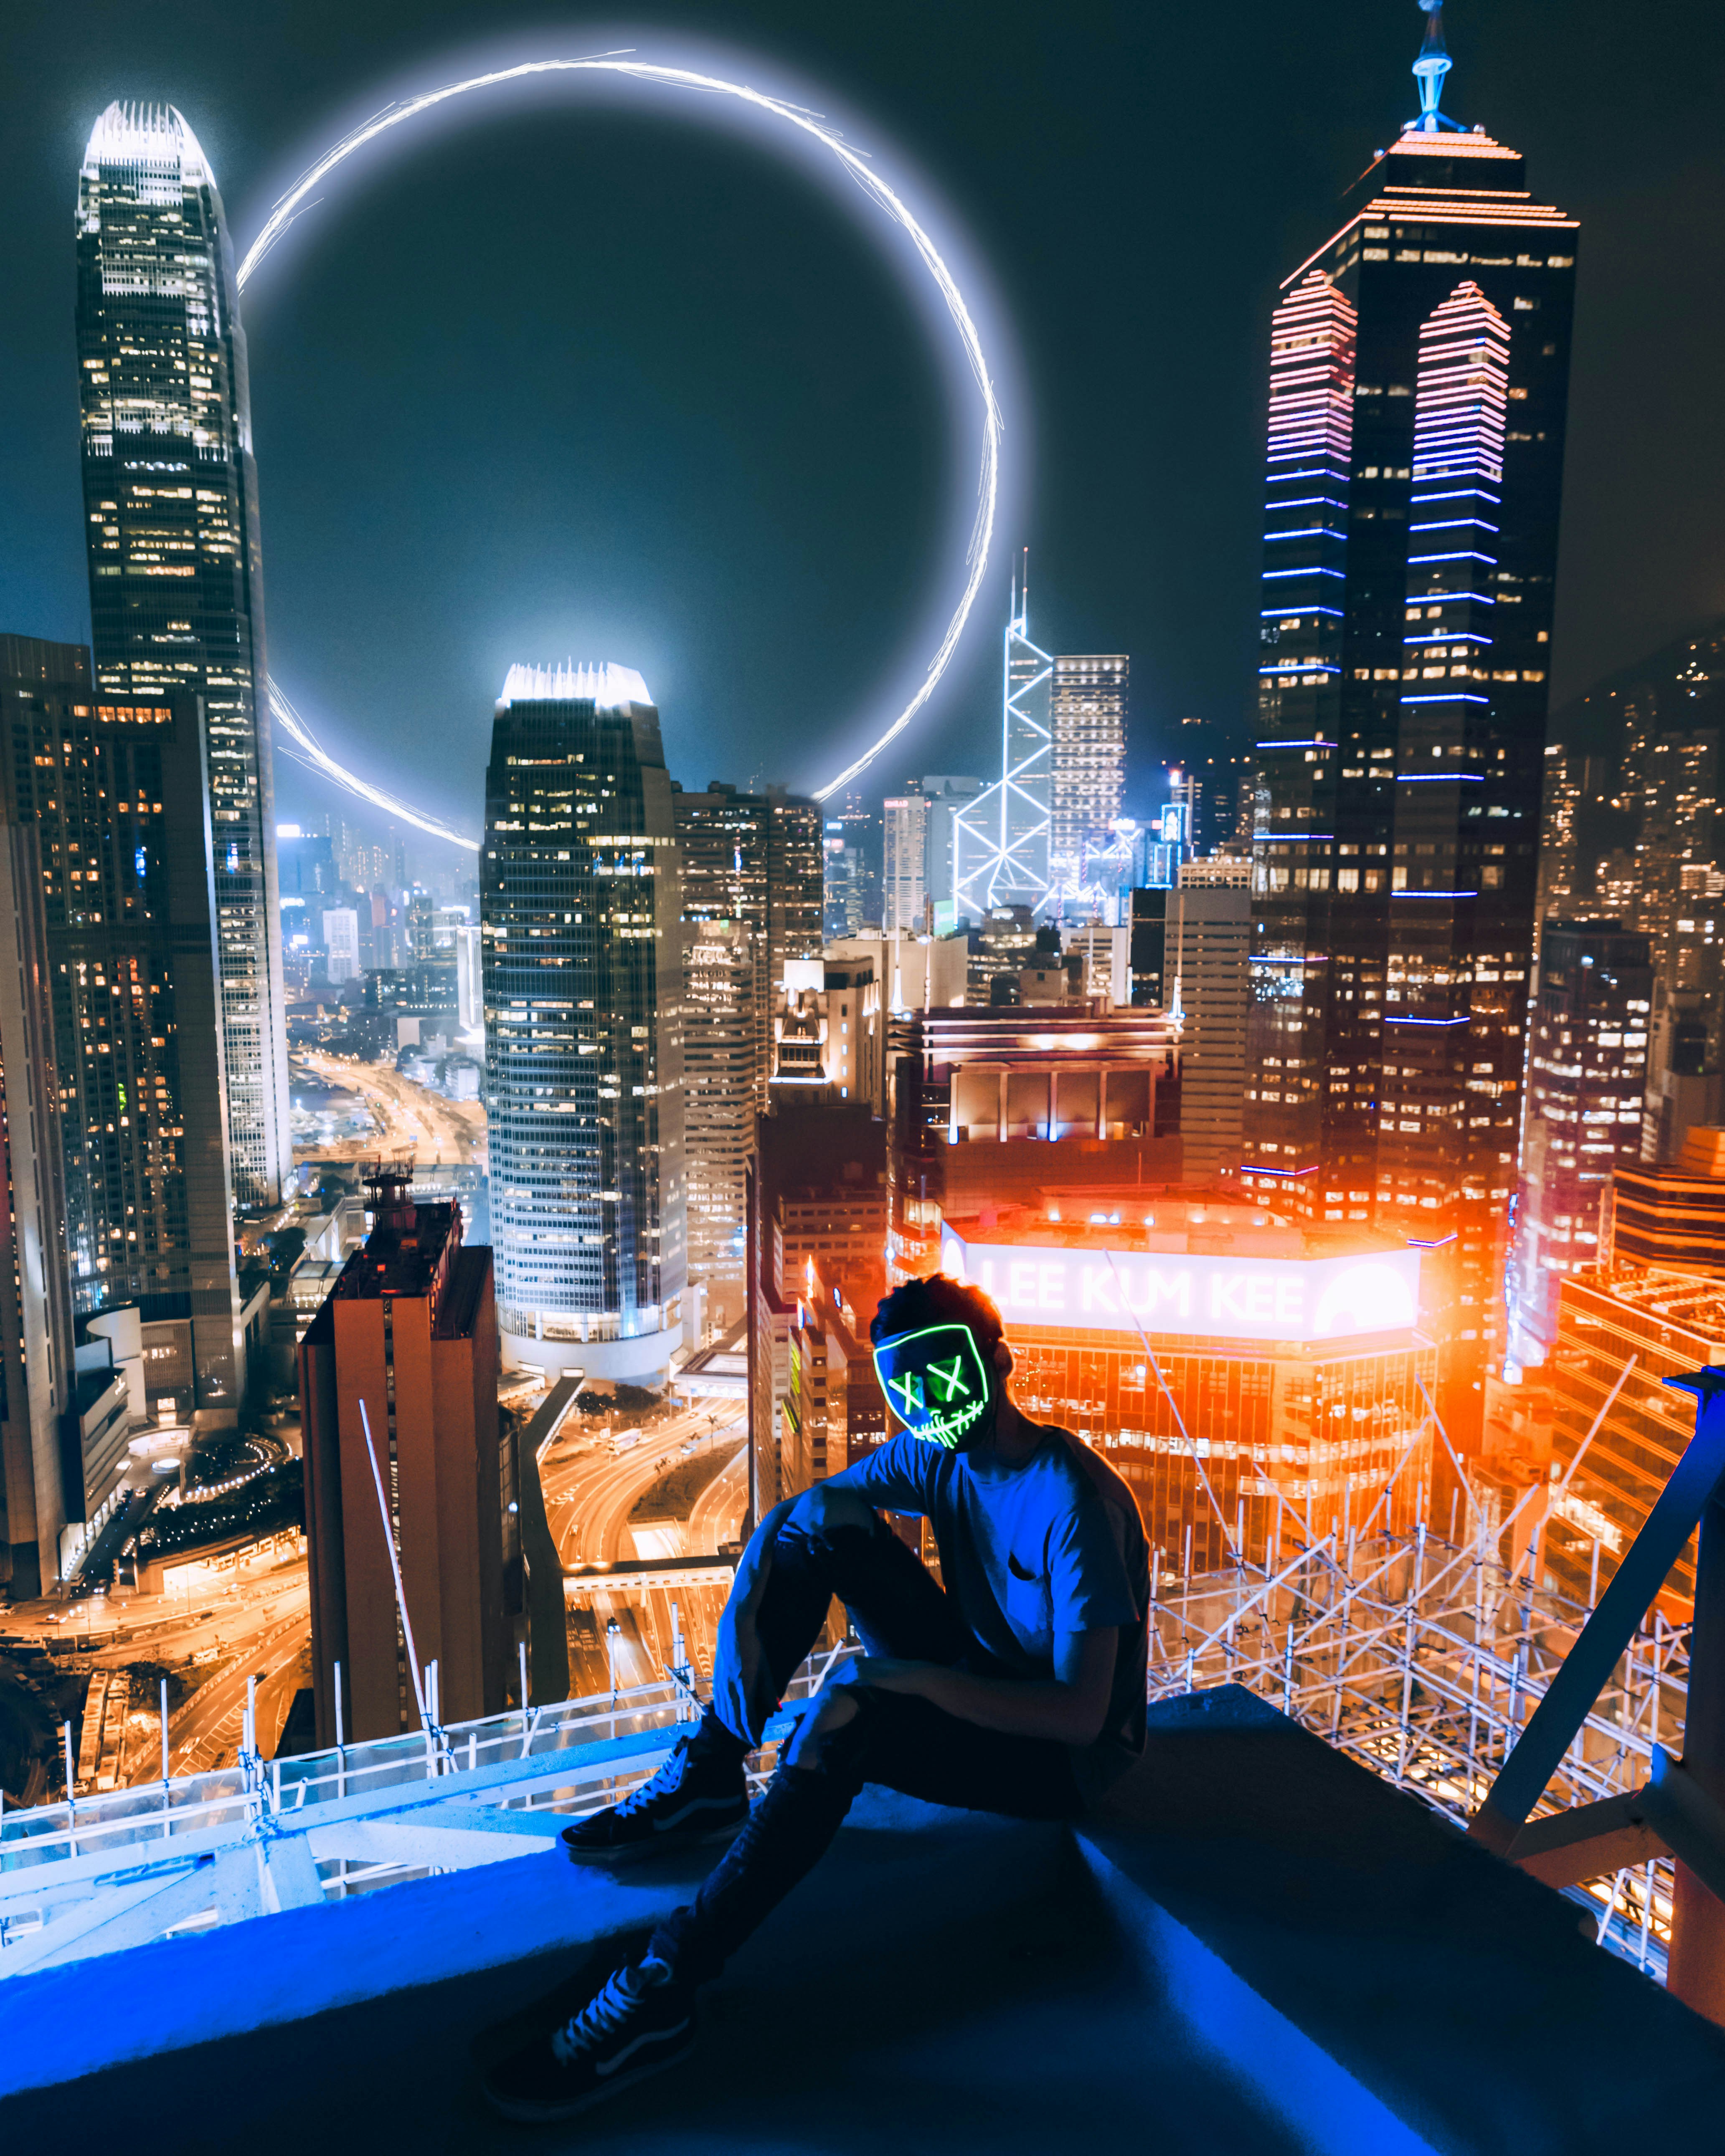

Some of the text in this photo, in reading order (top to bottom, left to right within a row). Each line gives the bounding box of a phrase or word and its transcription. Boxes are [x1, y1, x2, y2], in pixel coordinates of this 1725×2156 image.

[982, 1260, 1306, 1324] LEE KUM KEE
